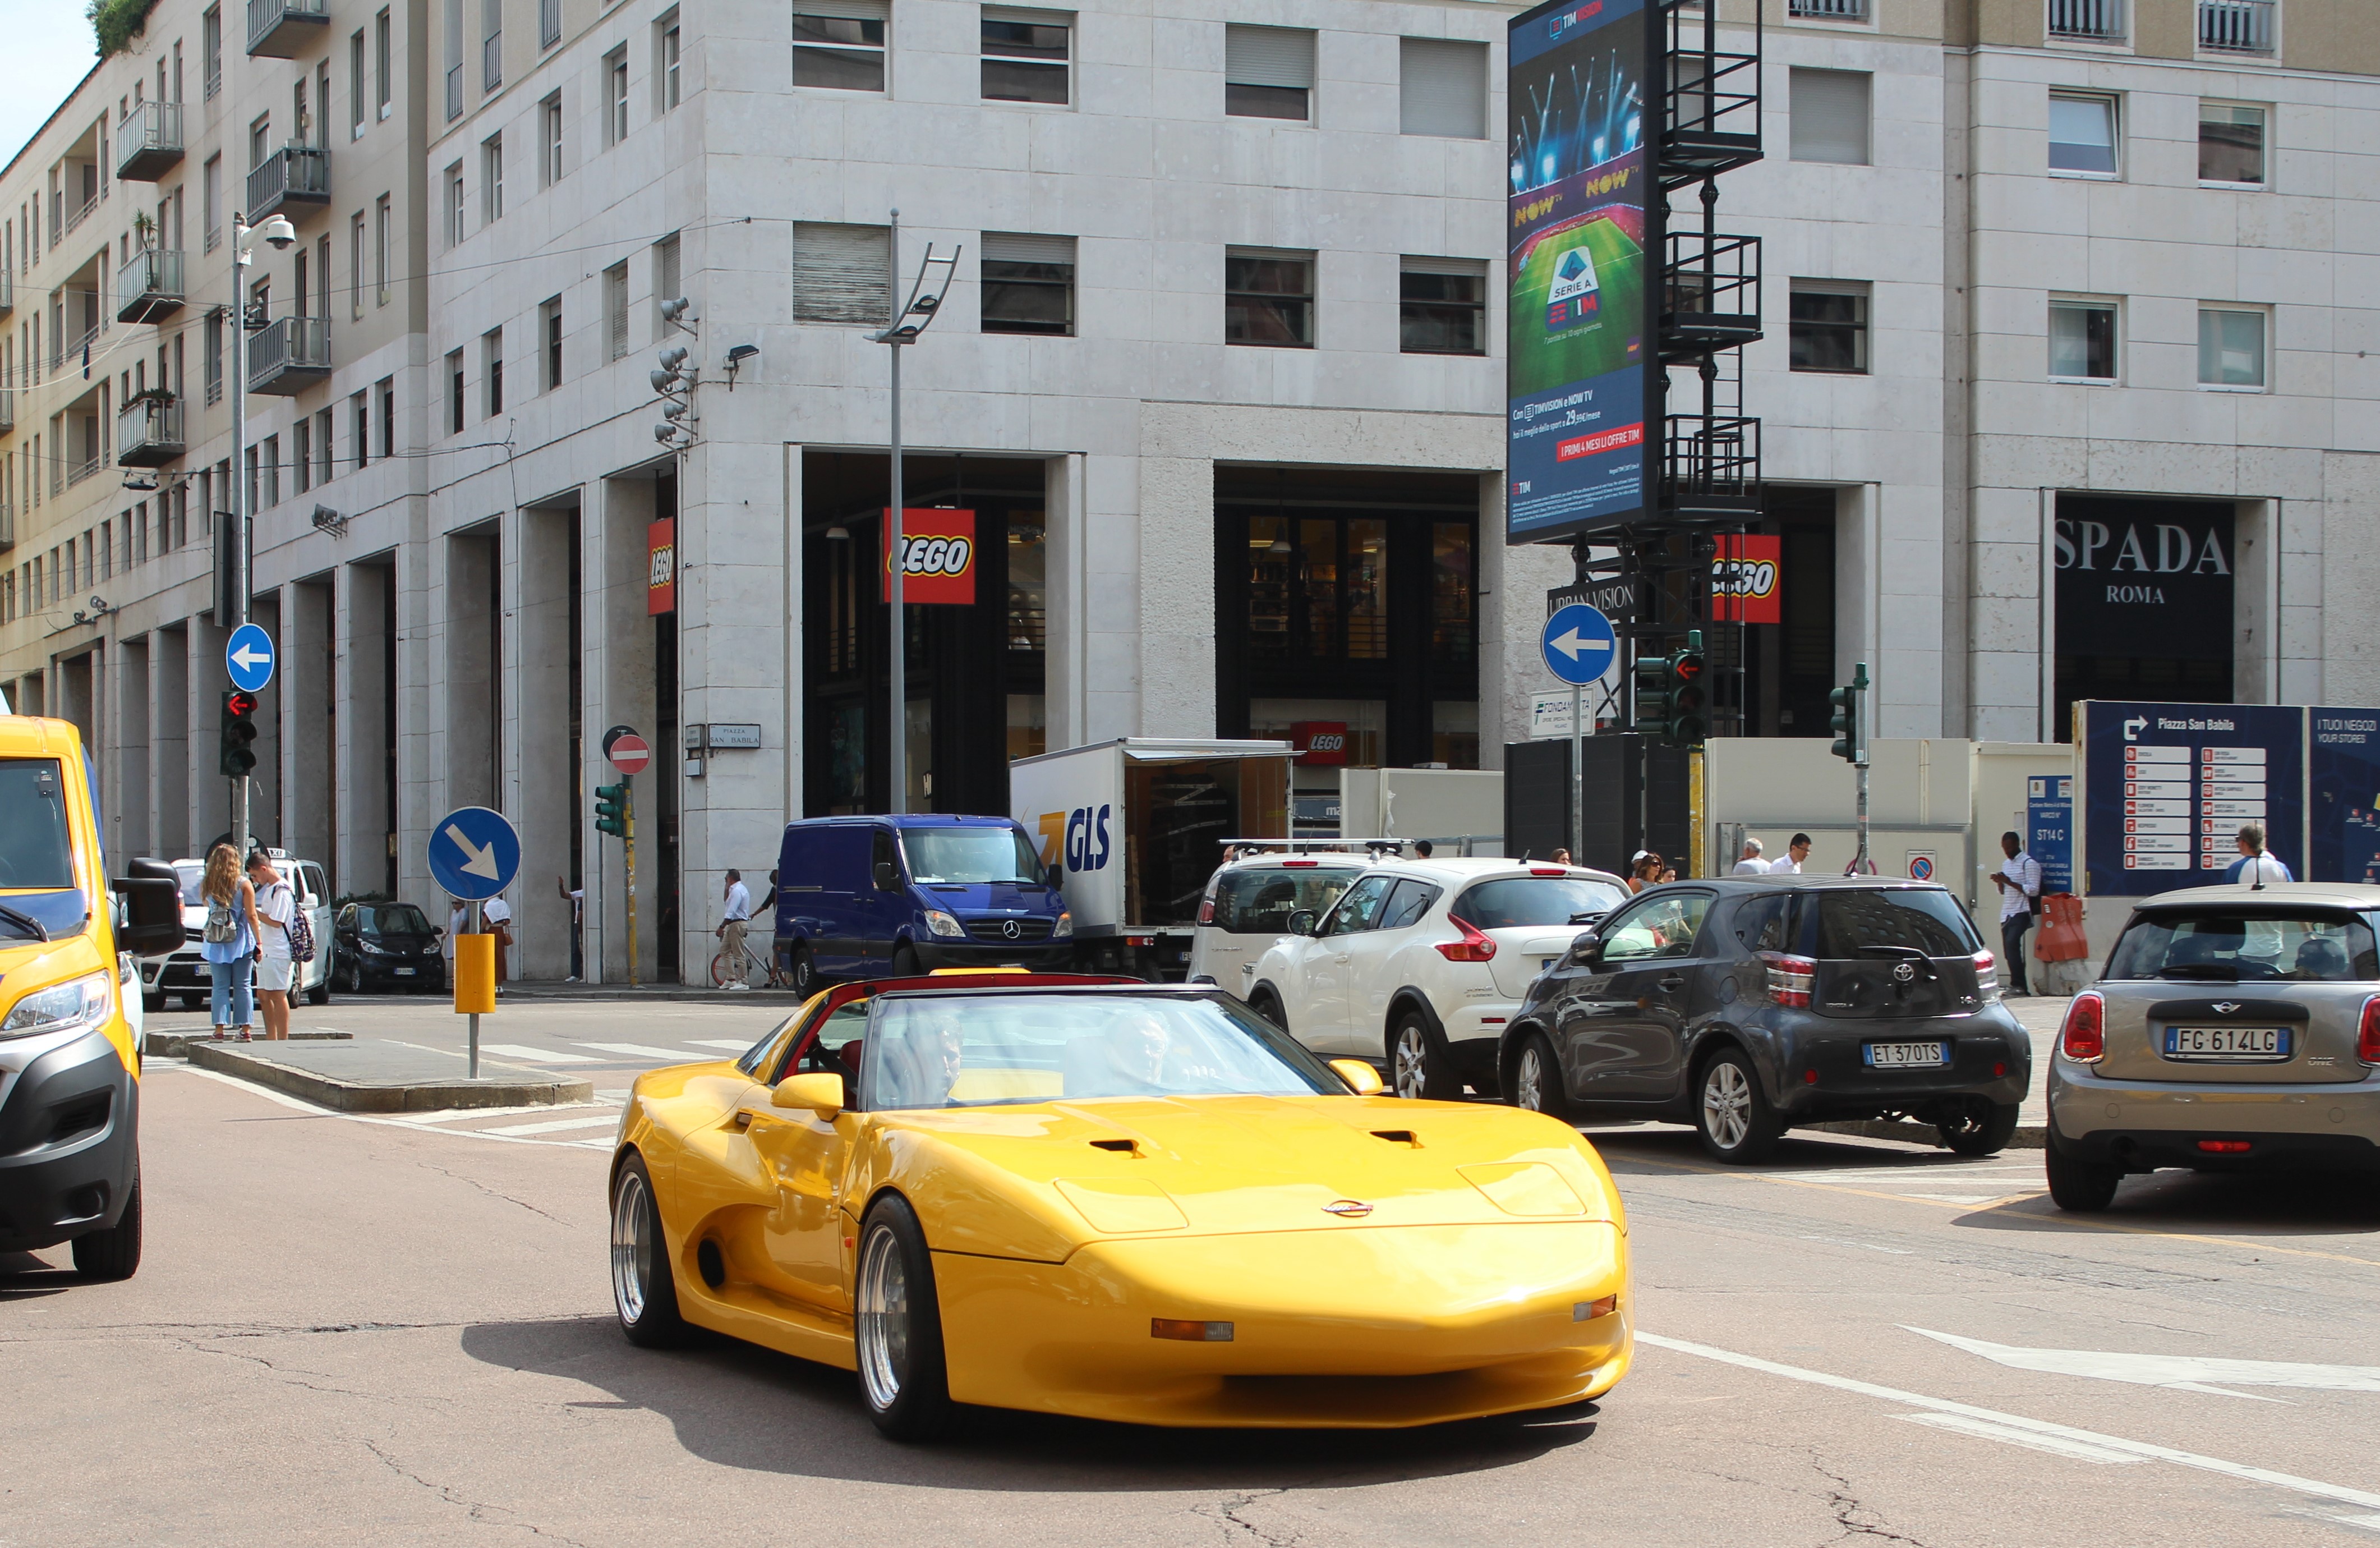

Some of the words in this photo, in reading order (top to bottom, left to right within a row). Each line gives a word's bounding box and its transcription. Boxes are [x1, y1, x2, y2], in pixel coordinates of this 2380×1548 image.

[1586, 168, 1629, 198] NOW
[1516, 196, 1554, 228] NOW
[1554, 282, 1581, 298] SERIE
[1568, 294, 1598, 318] TIM
[1513, 408, 1523, 421] Con
[1535, 398, 1563, 415] TIMVISION
[1568, 393, 1583, 406] NOW
[1584, 389, 1593, 401] TV
[1524, 426, 1538, 438] meglio
[1550, 420, 1562, 432] sport
[1564, 444, 1581, 457] PRIMI
[1581, 443, 1585, 452] 4
[1586, 439, 1600, 452] MESI
[1601, 437, 1607, 448] LI
[1608, 433, 1627, 447] OFFRE
[1628, 429, 1640, 442] TIM
[1519, 481, 1531, 494] TIM
[2054, 518, 2231, 575] SPADA
[651, 549, 671, 585] LEGO
[1592, 584, 1634, 610] VISION
[2106, 585, 2165, 604] ROMA
[2158, 718, 2186, 729] Piazza
[2188, 719, 2205, 730] San
[2207, 719, 2235, 731] Babila
[2317, 719, 2321, 730] I
[2322, 719, 2342, 731] TUOI
[2344, 720, 2377, 731] NEGOZI
[1311, 736, 1343, 750] LEGO
[2318, 734, 2337, 742] YOUR
[2338, 734, 2366, 743] STORES
[1066, 804, 1110, 872] GLS
[2037, 829, 2056, 840] ST14
[2057, 829, 2064, 840] C
[2308, 1057, 2335, 1065] ONE
